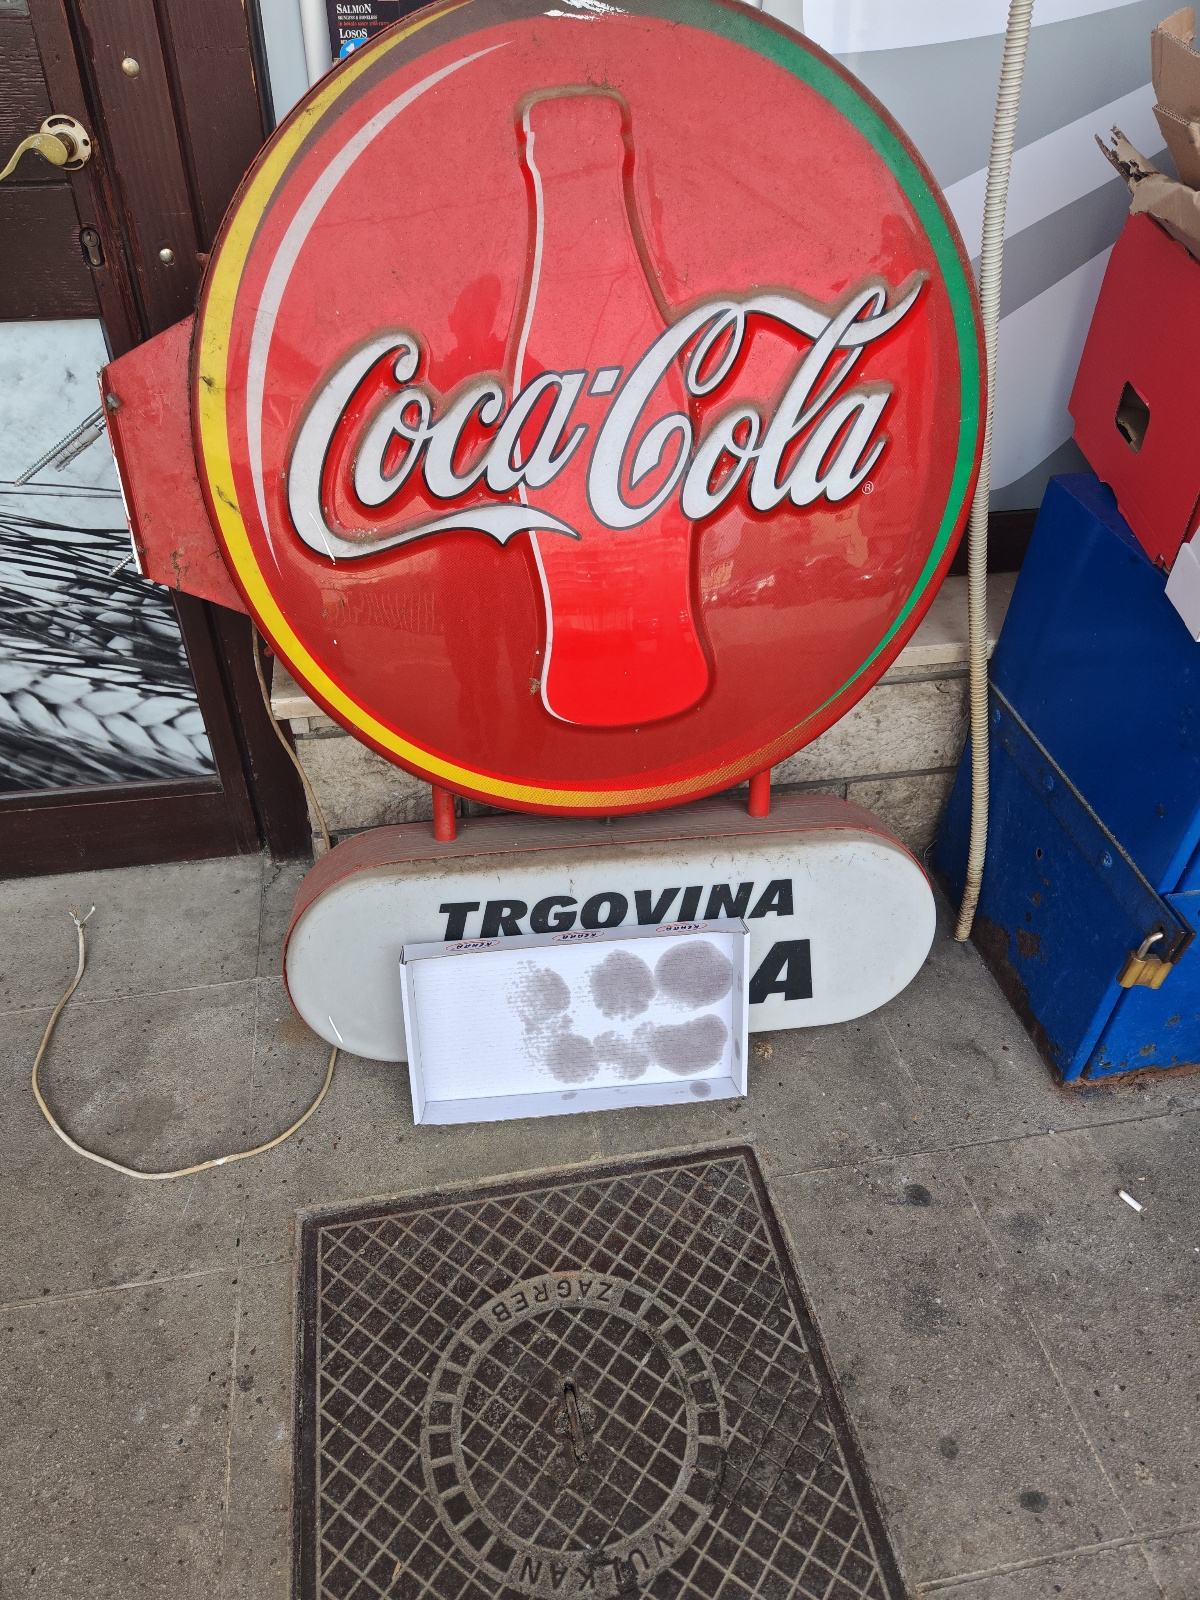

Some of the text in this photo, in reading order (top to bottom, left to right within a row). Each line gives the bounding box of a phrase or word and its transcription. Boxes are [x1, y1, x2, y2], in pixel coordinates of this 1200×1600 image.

[287, 273, 927, 560] Coca-Cola
[439, 878, 794, 942] TRGOVINA
[490, 1277, 614, 1322] ZAGREB
[518, 1532, 676, 1590] VULKAN
